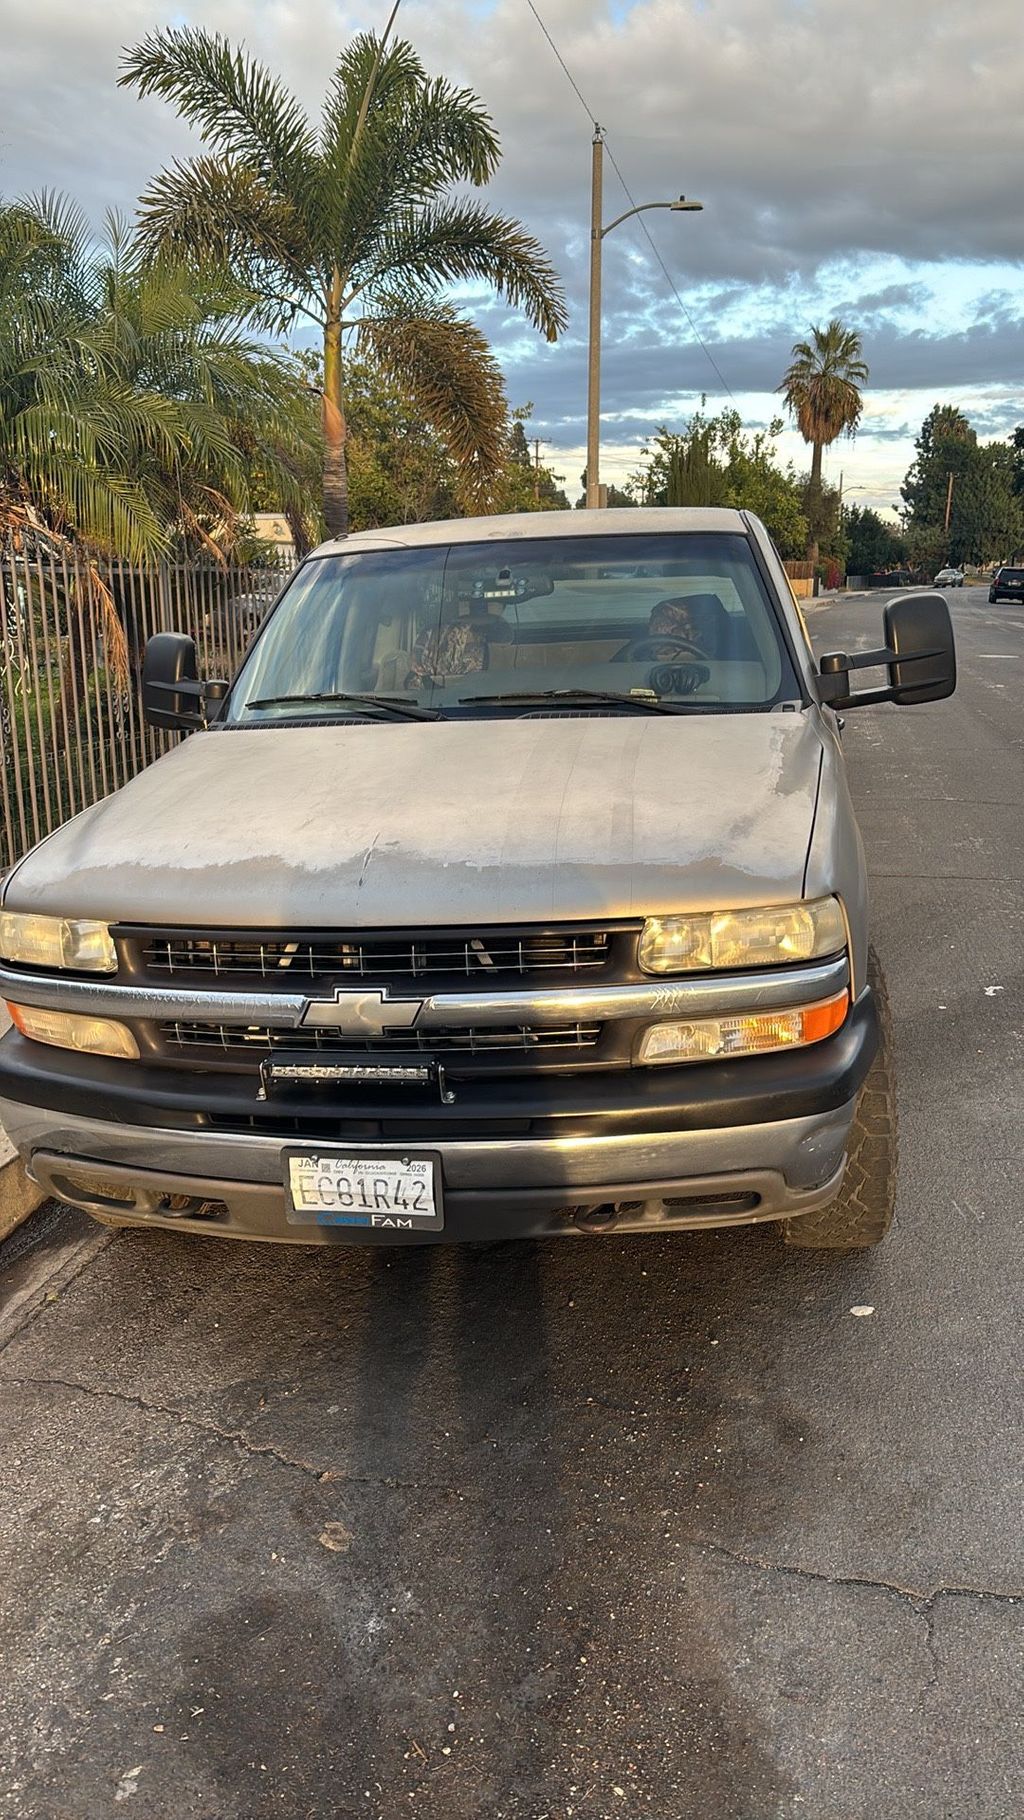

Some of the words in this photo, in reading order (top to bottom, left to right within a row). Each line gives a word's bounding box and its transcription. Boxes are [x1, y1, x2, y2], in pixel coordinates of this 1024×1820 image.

[298, 1158, 319, 1169] JAN
[335, 1158, 386, 1175] California
[406, 1163, 427, 1173] 2026
[299, 1175, 428, 1212] EC81R42
